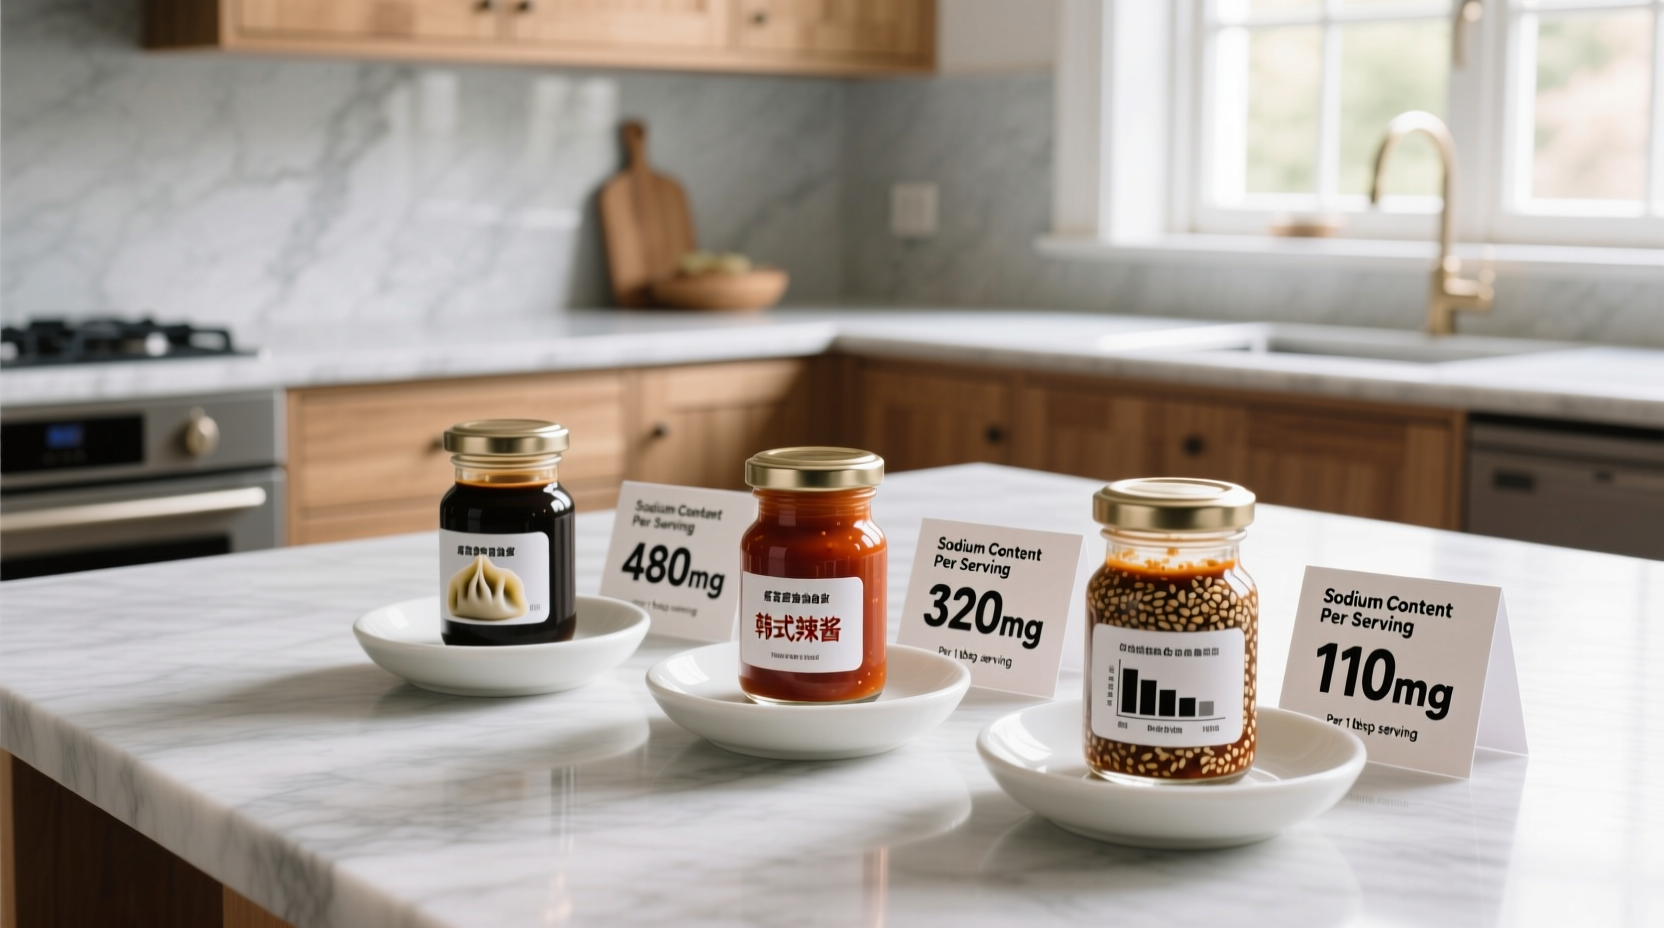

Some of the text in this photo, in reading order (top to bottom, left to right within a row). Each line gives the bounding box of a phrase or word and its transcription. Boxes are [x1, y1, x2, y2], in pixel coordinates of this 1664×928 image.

[635, 499, 723, 521] Sodium Content
[632, 515, 696, 536] Per Serving
[937, 536, 1043, 562] Sodium Content
[621, 542, 725, 599] 480mg
[934, 554, 1011, 579] Per Serving
[923, 583, 1044, 650] 320mg
[1323, 587, 1454, 618] Sodium Content
[1320, 607, 1415, 639] Per Serving
[1316, 642, 1454, 721] 110mg
[1326, 713, 1343, 727] Per
[1345, 717, 1350, 729] 1
[1378, 725, 1418, 743] serving
